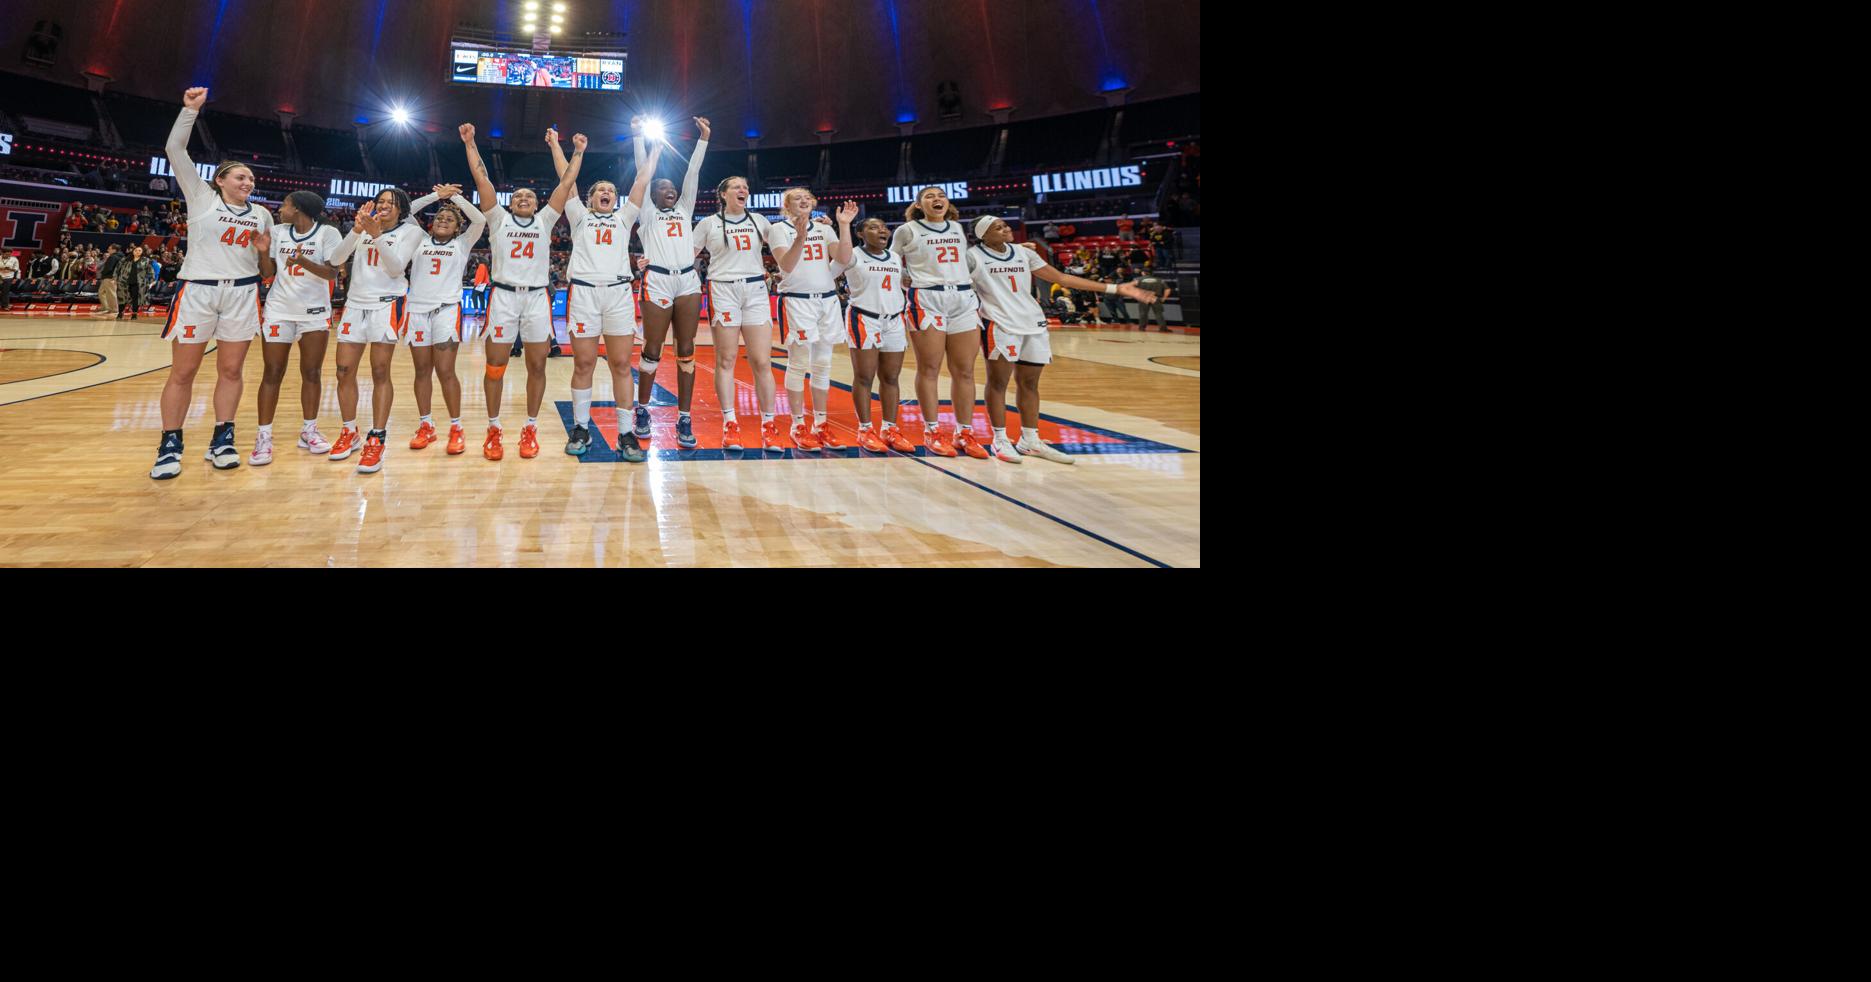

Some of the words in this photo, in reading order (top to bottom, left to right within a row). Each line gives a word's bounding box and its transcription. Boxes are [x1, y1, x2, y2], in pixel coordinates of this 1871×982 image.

[1032, 165, 1142, 193] ILLINOIS
[331, 179, 395, 198] ILLINO
[888, 182, 968, 203] ILLIIS
[218, 216, 258, 228] ILLINOIS
[666, 222, 683, 237] 21
[220, 226, 251, 248] 44
[595, 229, 612, 245] 14
[733, 235, 751, 251] 13
[367, 247, 379, 266] 11
[511, 241, 534, 258] 24
[803, 243, 823, 261] 33
[936, 246, 959, 263] 23
[430, 258, 441, 275] 3
[881, 274, 892, 291] 4
[1008, 275, 1017, 293] 1
